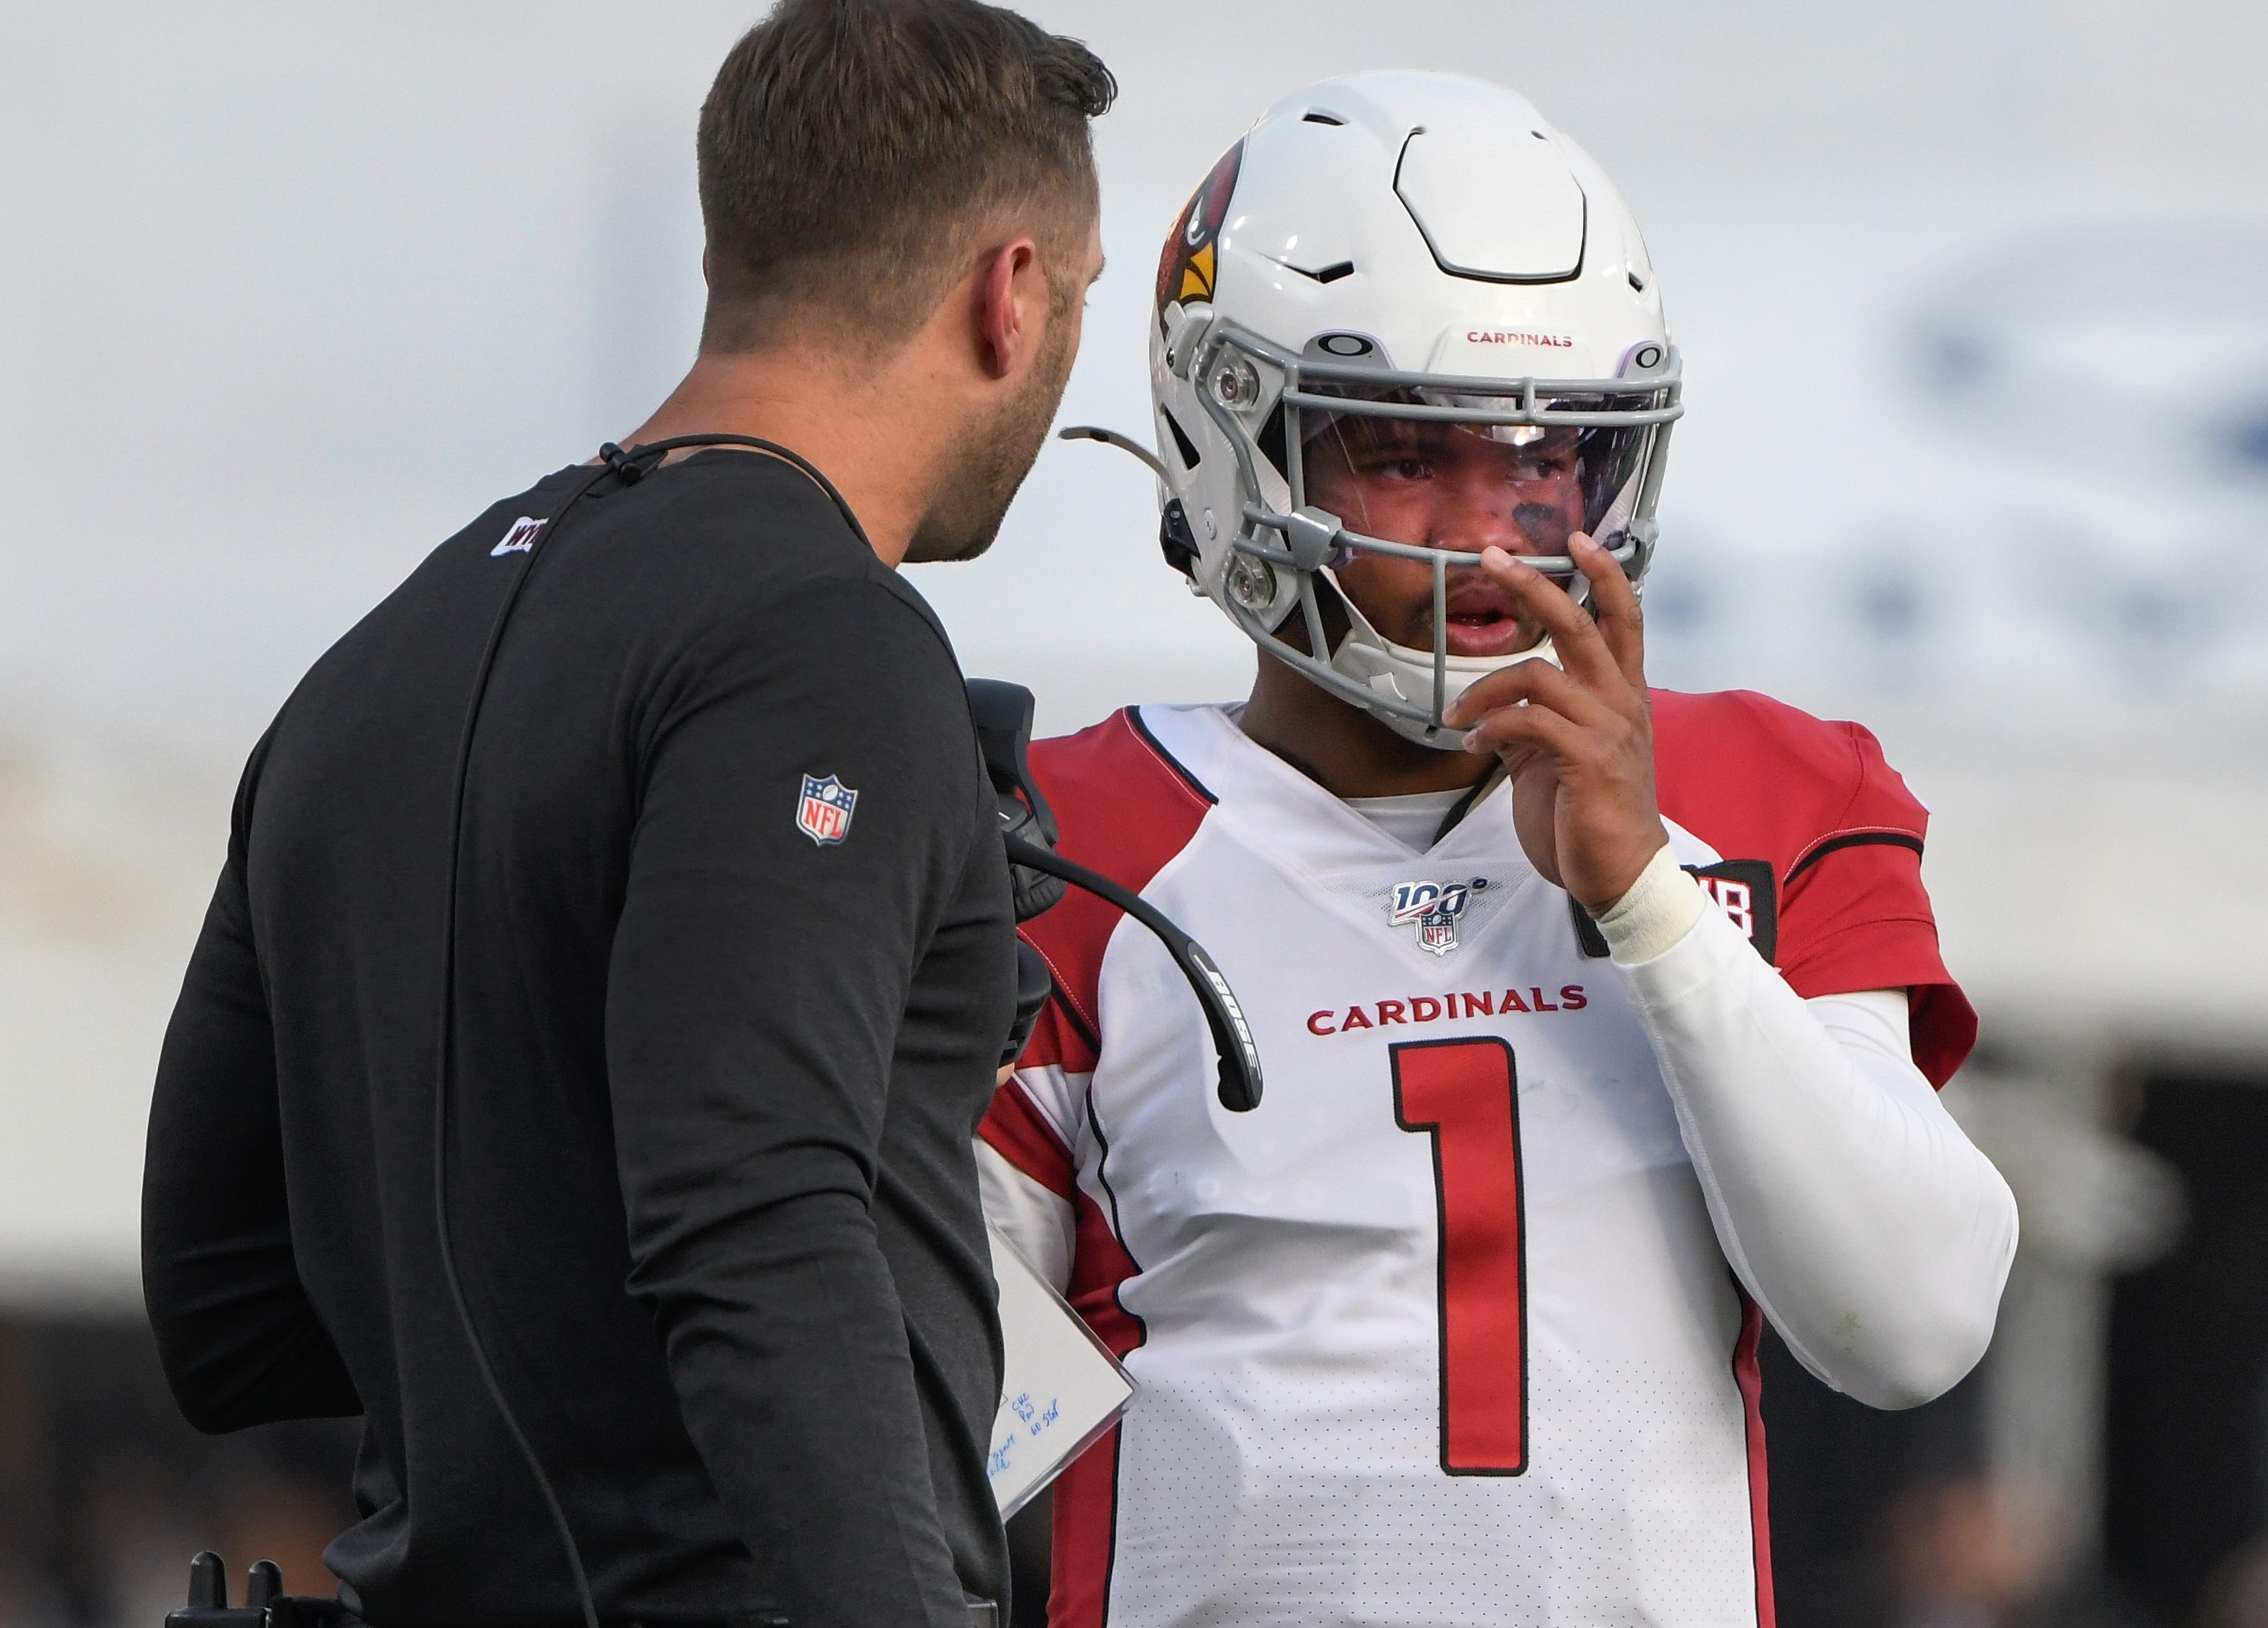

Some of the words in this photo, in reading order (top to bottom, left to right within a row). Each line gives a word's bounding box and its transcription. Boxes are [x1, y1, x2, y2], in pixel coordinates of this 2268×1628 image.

[1467, 330, 1573, 348] CARDINALS
[804, 800, 842, 838] NFL
[1425, 927, 1452, 944] NFL
[1193, 953, 1262, 1081] BOSE
[1306, 984, 1588, 1036] CARDINALS
[1388, 1035, 1529, 1476] 1
